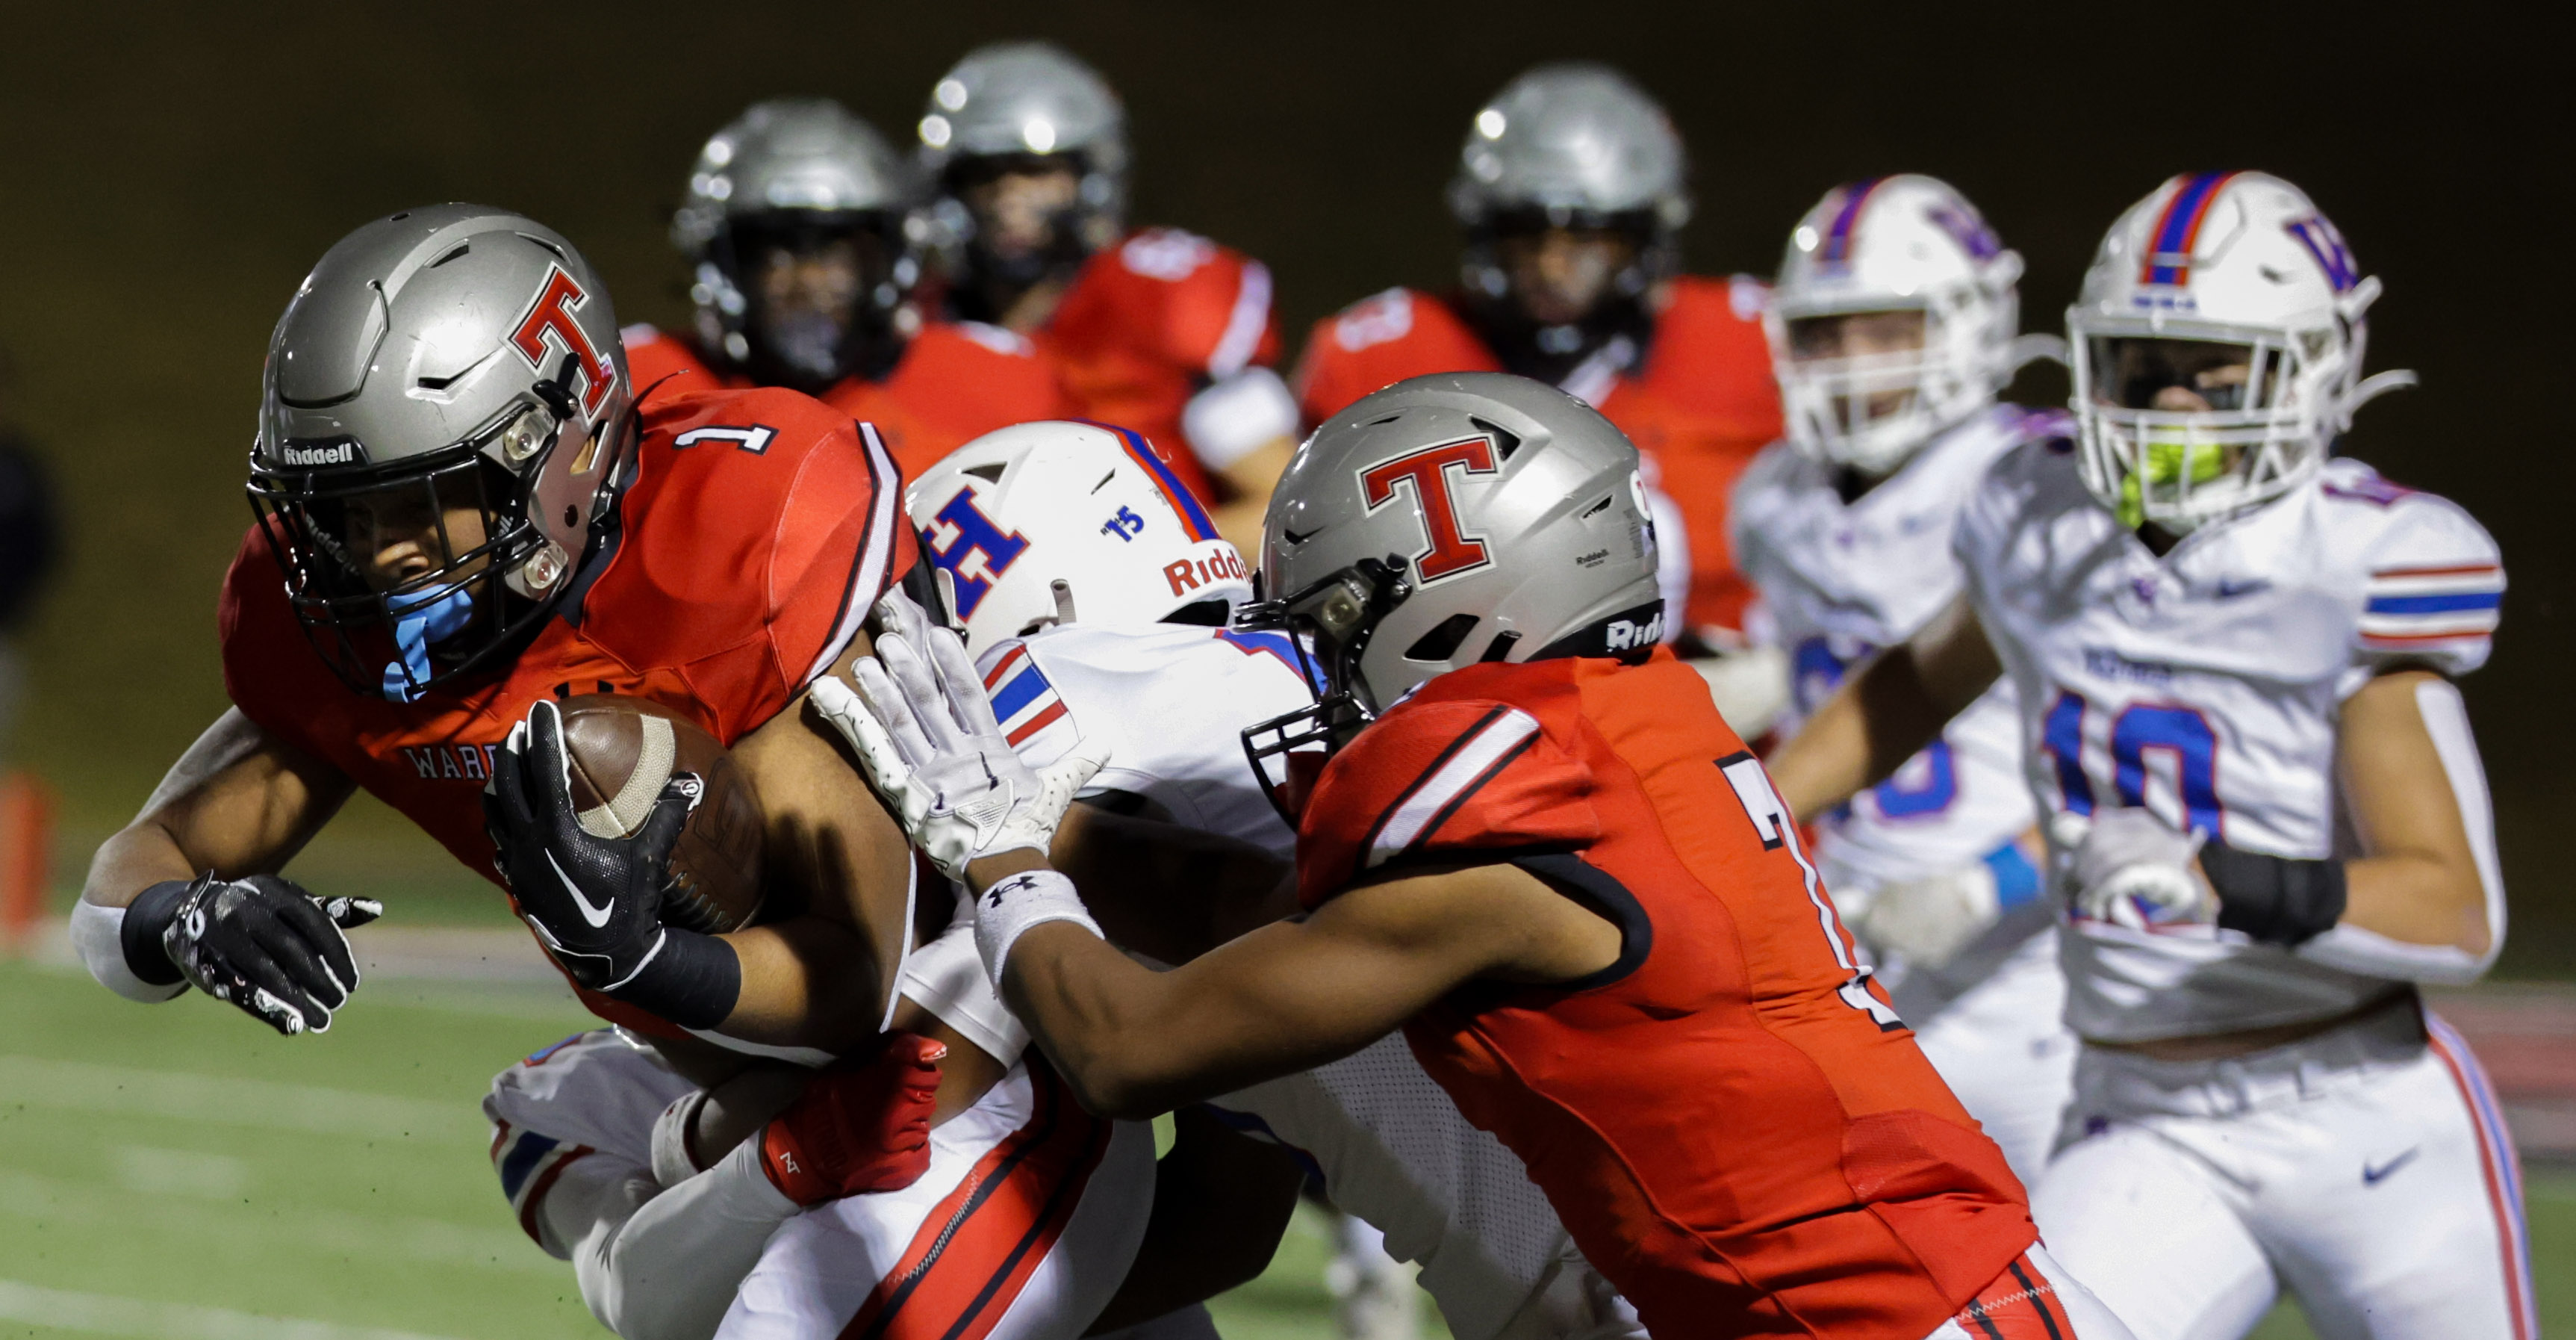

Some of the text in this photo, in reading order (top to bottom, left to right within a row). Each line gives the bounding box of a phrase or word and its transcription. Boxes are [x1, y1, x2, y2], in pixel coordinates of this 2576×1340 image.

[499, 261, 615, 424] T
[284, 442, 353, 465] Riddell
[675, 422, 779, 456] 1
[921, 485, 1031, 623] H
[1104, 504, 1145, 544] 15
[1355, 432, 1503, 591] T
